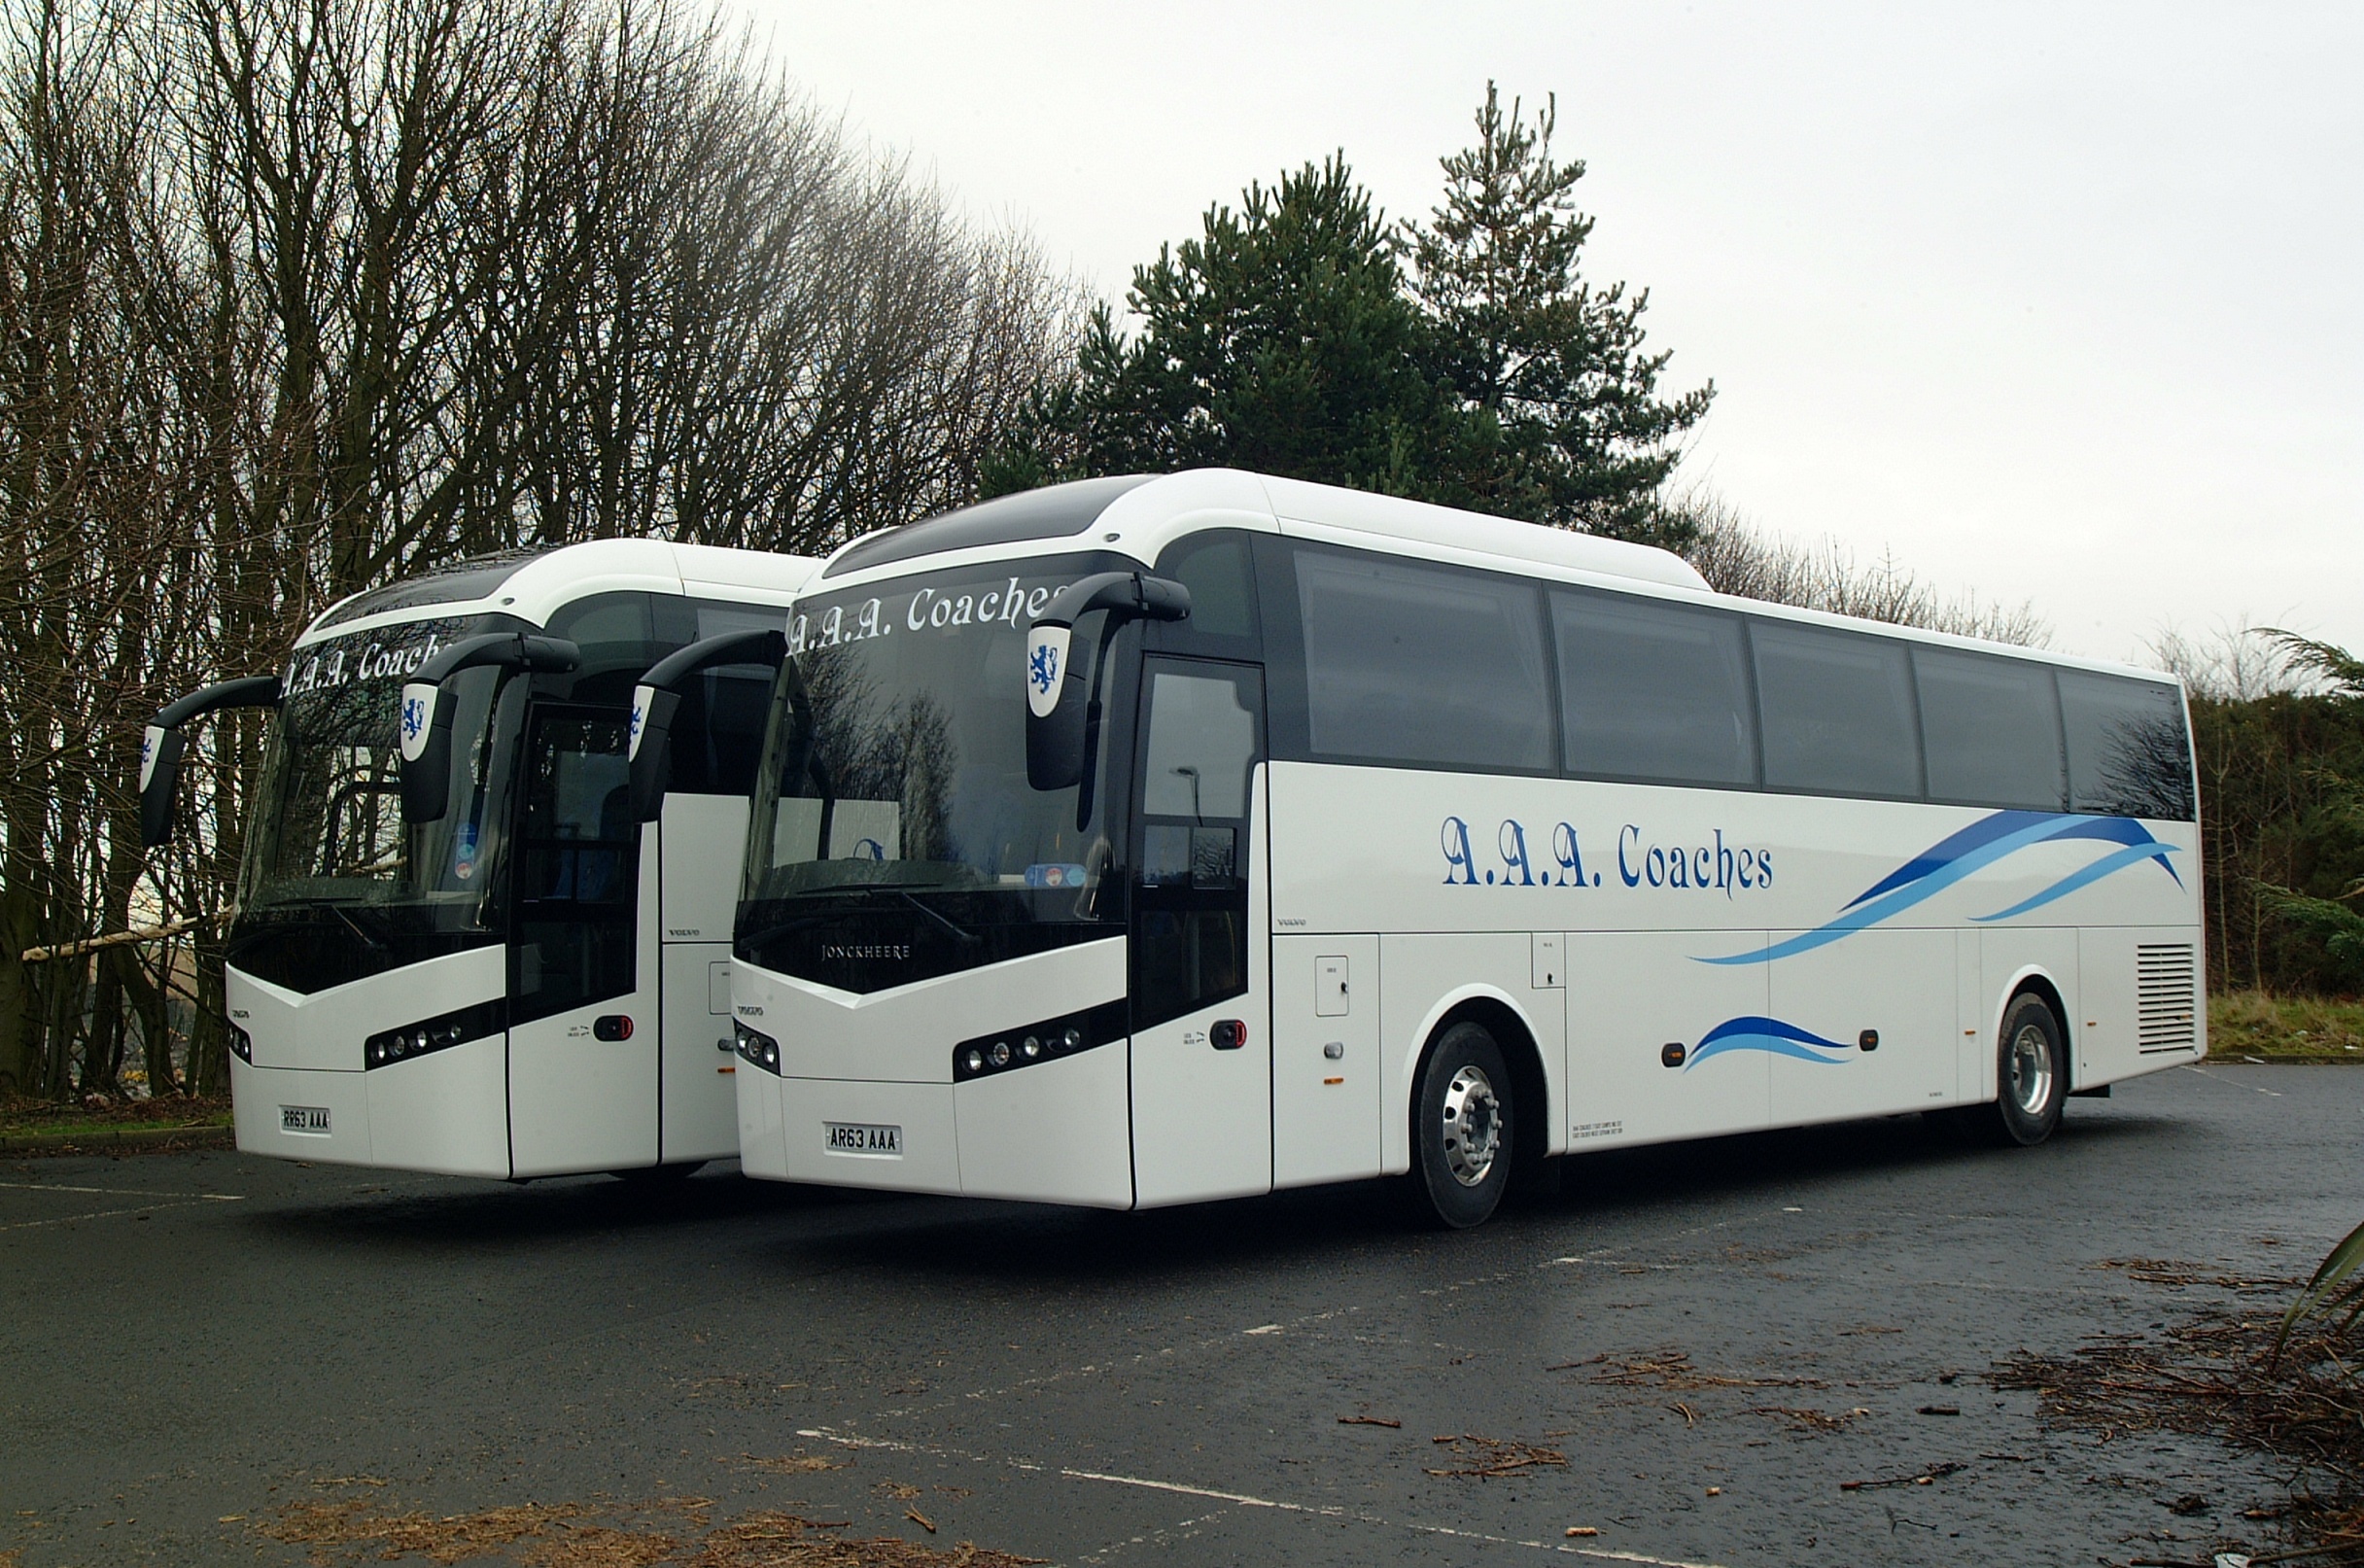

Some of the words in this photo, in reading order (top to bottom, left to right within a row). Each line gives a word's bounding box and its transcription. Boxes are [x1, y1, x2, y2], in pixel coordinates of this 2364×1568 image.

[1618, 823, 1773, 902] Coaches
[821, 944, 911, 961] JONCKHEERE
[309, 1111, 329, 1131] AAA
[830, 1128, 864, 1148] AR63
[868, 1130, 896, 1151] AAA
